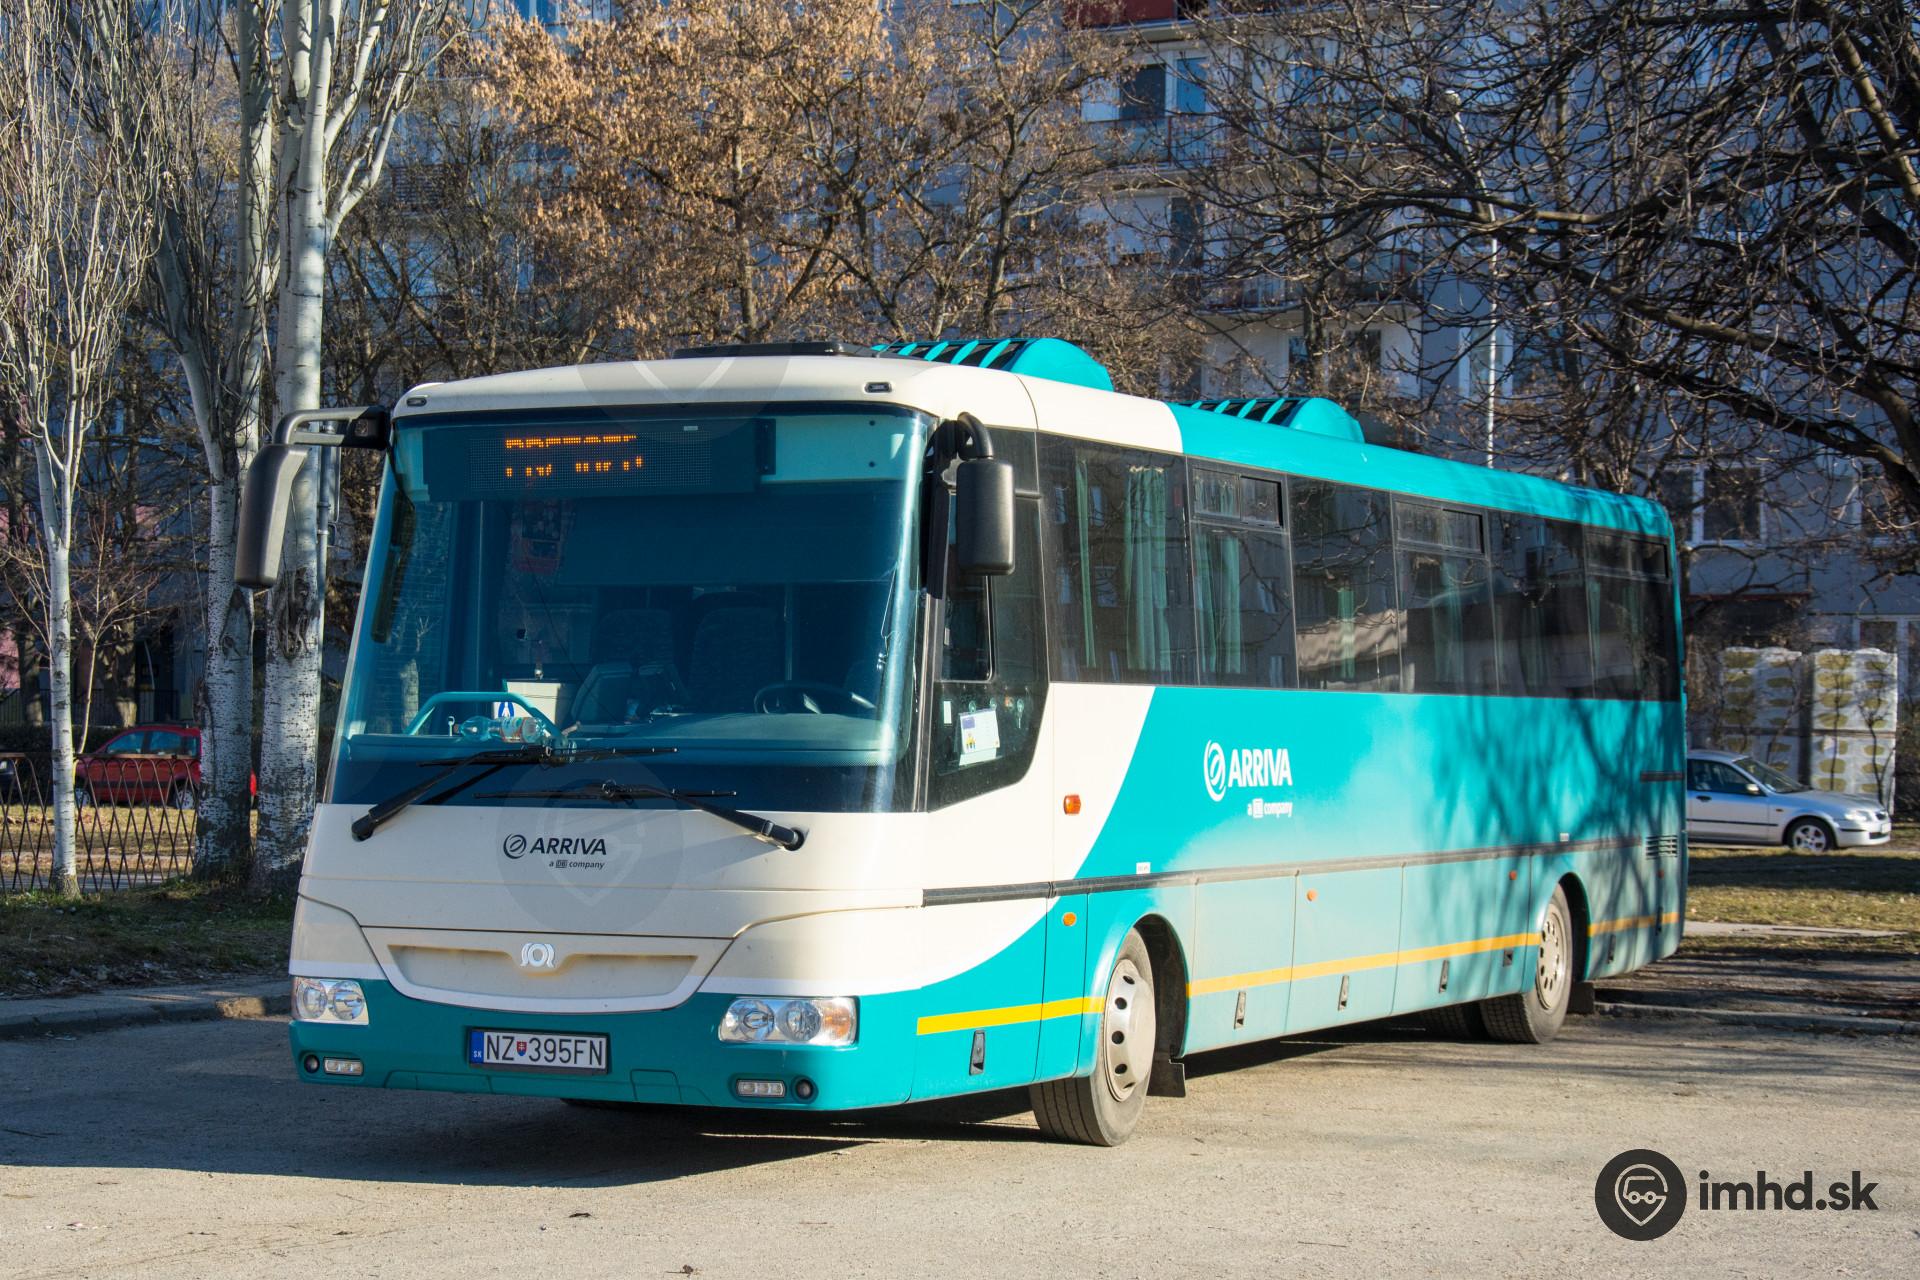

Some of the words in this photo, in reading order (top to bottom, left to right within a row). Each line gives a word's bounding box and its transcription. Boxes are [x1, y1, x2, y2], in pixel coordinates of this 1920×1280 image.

[1228, 748, 1293, 787] ARRIVA
[530, 837, 607, 856] ARRIVA
[569, 861, 605, 870] company
[528, 1037, 602, 1066] 395FN
